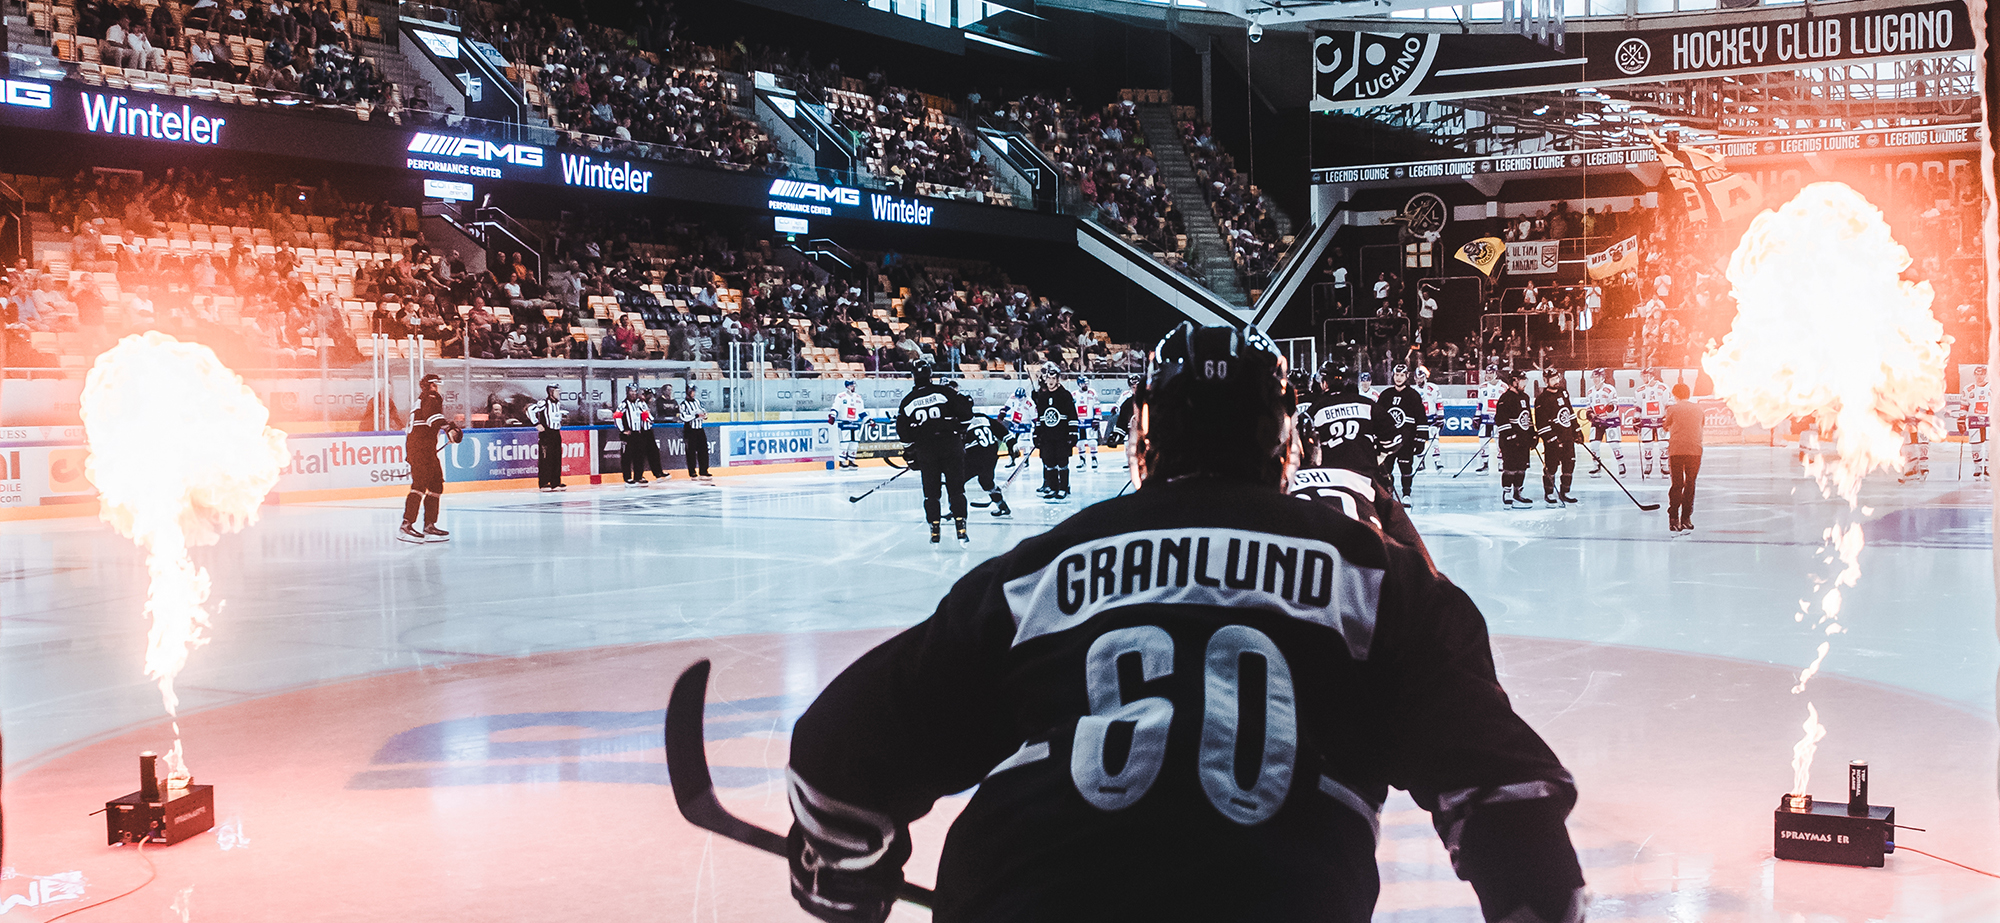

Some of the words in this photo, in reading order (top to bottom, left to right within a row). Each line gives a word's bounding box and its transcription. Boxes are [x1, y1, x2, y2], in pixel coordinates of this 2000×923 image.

[1673, 25, 1769, 71] HOCKEY
[1777, 18, 1841, 62] CLUB
[1849, 8, 1954, 56] LUGANO
[1355, 36, 1421, 98] LUGANO
[81, 91, 226, 145] Winteler
[1781, 137, 1822, 153] LEGENDS
[1823, 135, 1860, 151] LOUNGE
[1884, 130, 1928, 147] LEGENDS
[1929, 128, 1968, 145] LOUNGE
[451, 137, 544, 167] AMG
[1586, 151, 1624, 166] LEGENDS
[1625, 149, 1660, 164] LOUNGE
[1722, 142, 1758, 157] LOUNGE
[406, 158, 469, 176] PERFORMANCE
[469, 166, 502, 179] CENTER
[560, 152, 653, 194] Winteler
[1408, 163, 1444, 178] LEGENDS
[1445, 161, 1476, 176] LOUNGE
[1495, 157, 1532, 172] LEGENDS
[1533, 155, 1566, 170] LOUNGE
[1325, 169, 1359, 183] LEGENDS
[1360, 168, 1390, 182] LOUNGE
[799, 182, 861, 206] AMG
[768, 199, 811, 214] PERFORMANCE
[810, 206, 833, 216] CENTER
[870, 193, 934, 226] Winteler
[1204, 359, 1228, 379] 60
[1324, 405, 1360, 420] BENNETT
[748, 437, 813, 456] FORNONI
[506, 464, 539, 477] generatio
[1055, 536, 1335, 617] GRANLUND
[1070, 624, 1299, 827] 60
